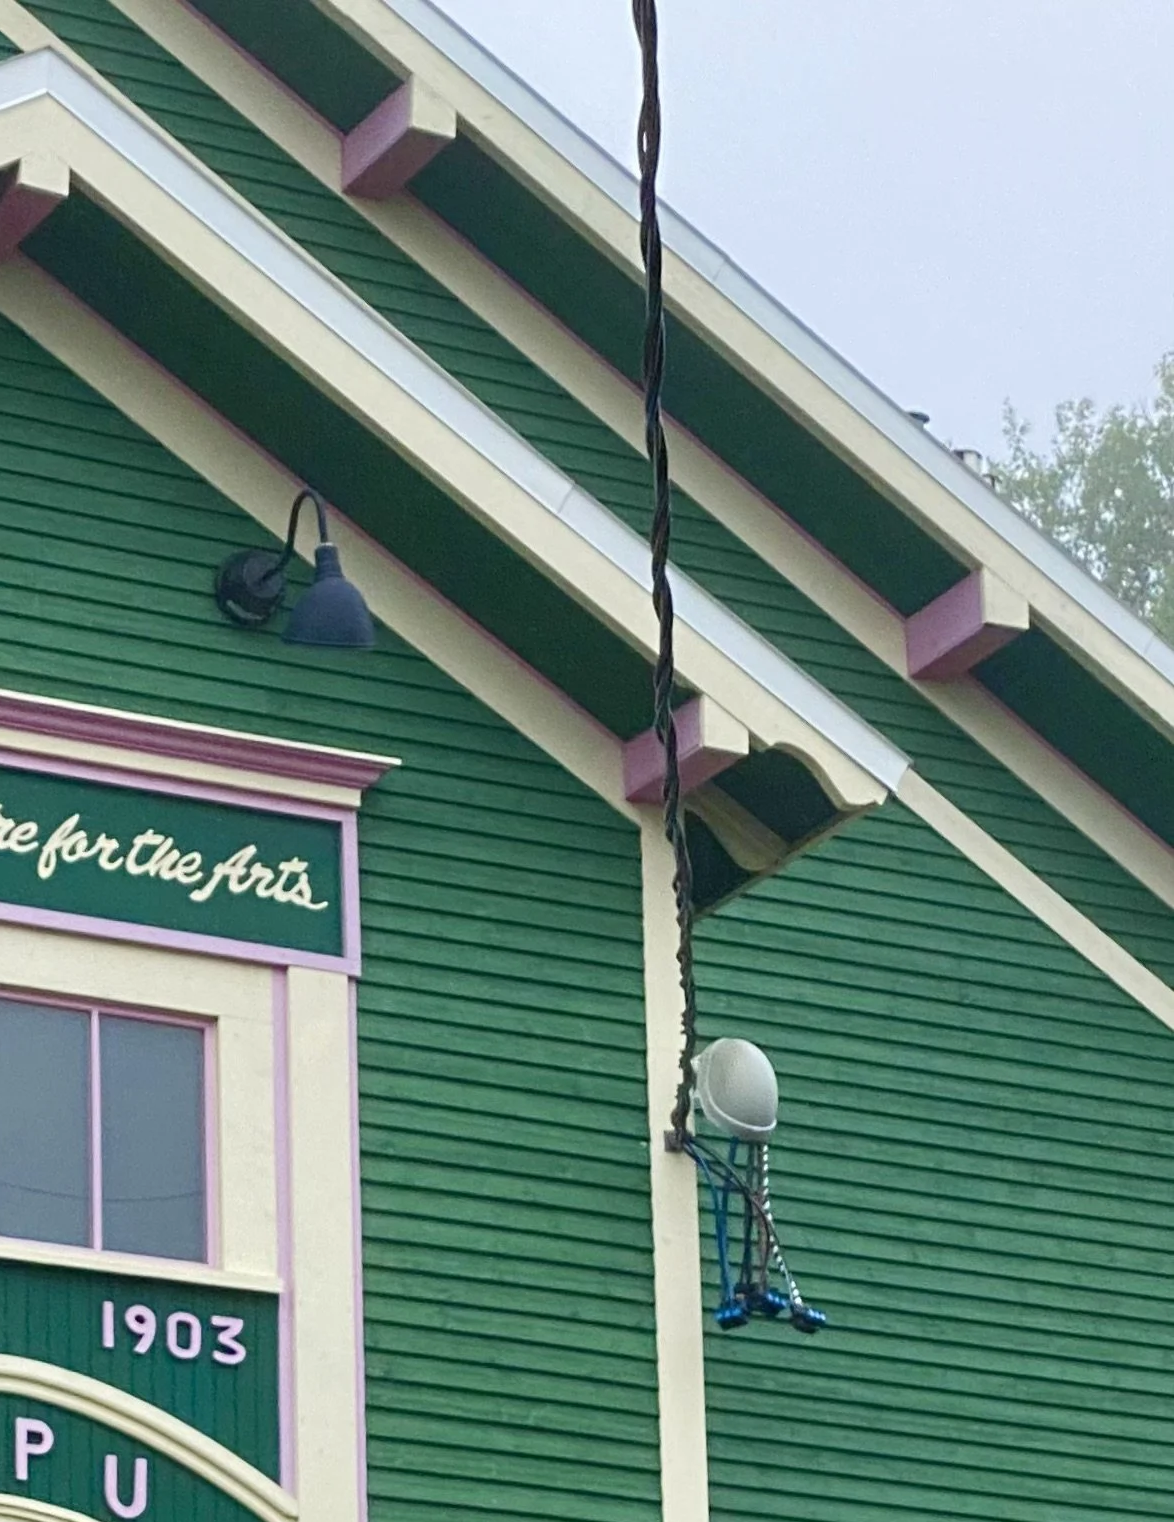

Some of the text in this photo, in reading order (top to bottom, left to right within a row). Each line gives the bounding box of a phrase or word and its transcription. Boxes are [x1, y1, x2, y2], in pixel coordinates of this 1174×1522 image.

[37, 814, 128, 879] for
[124, 828, 204, 886] the
[189, 845, 328, 911] Arts
[102, 1301, 247, 1365] 1903
